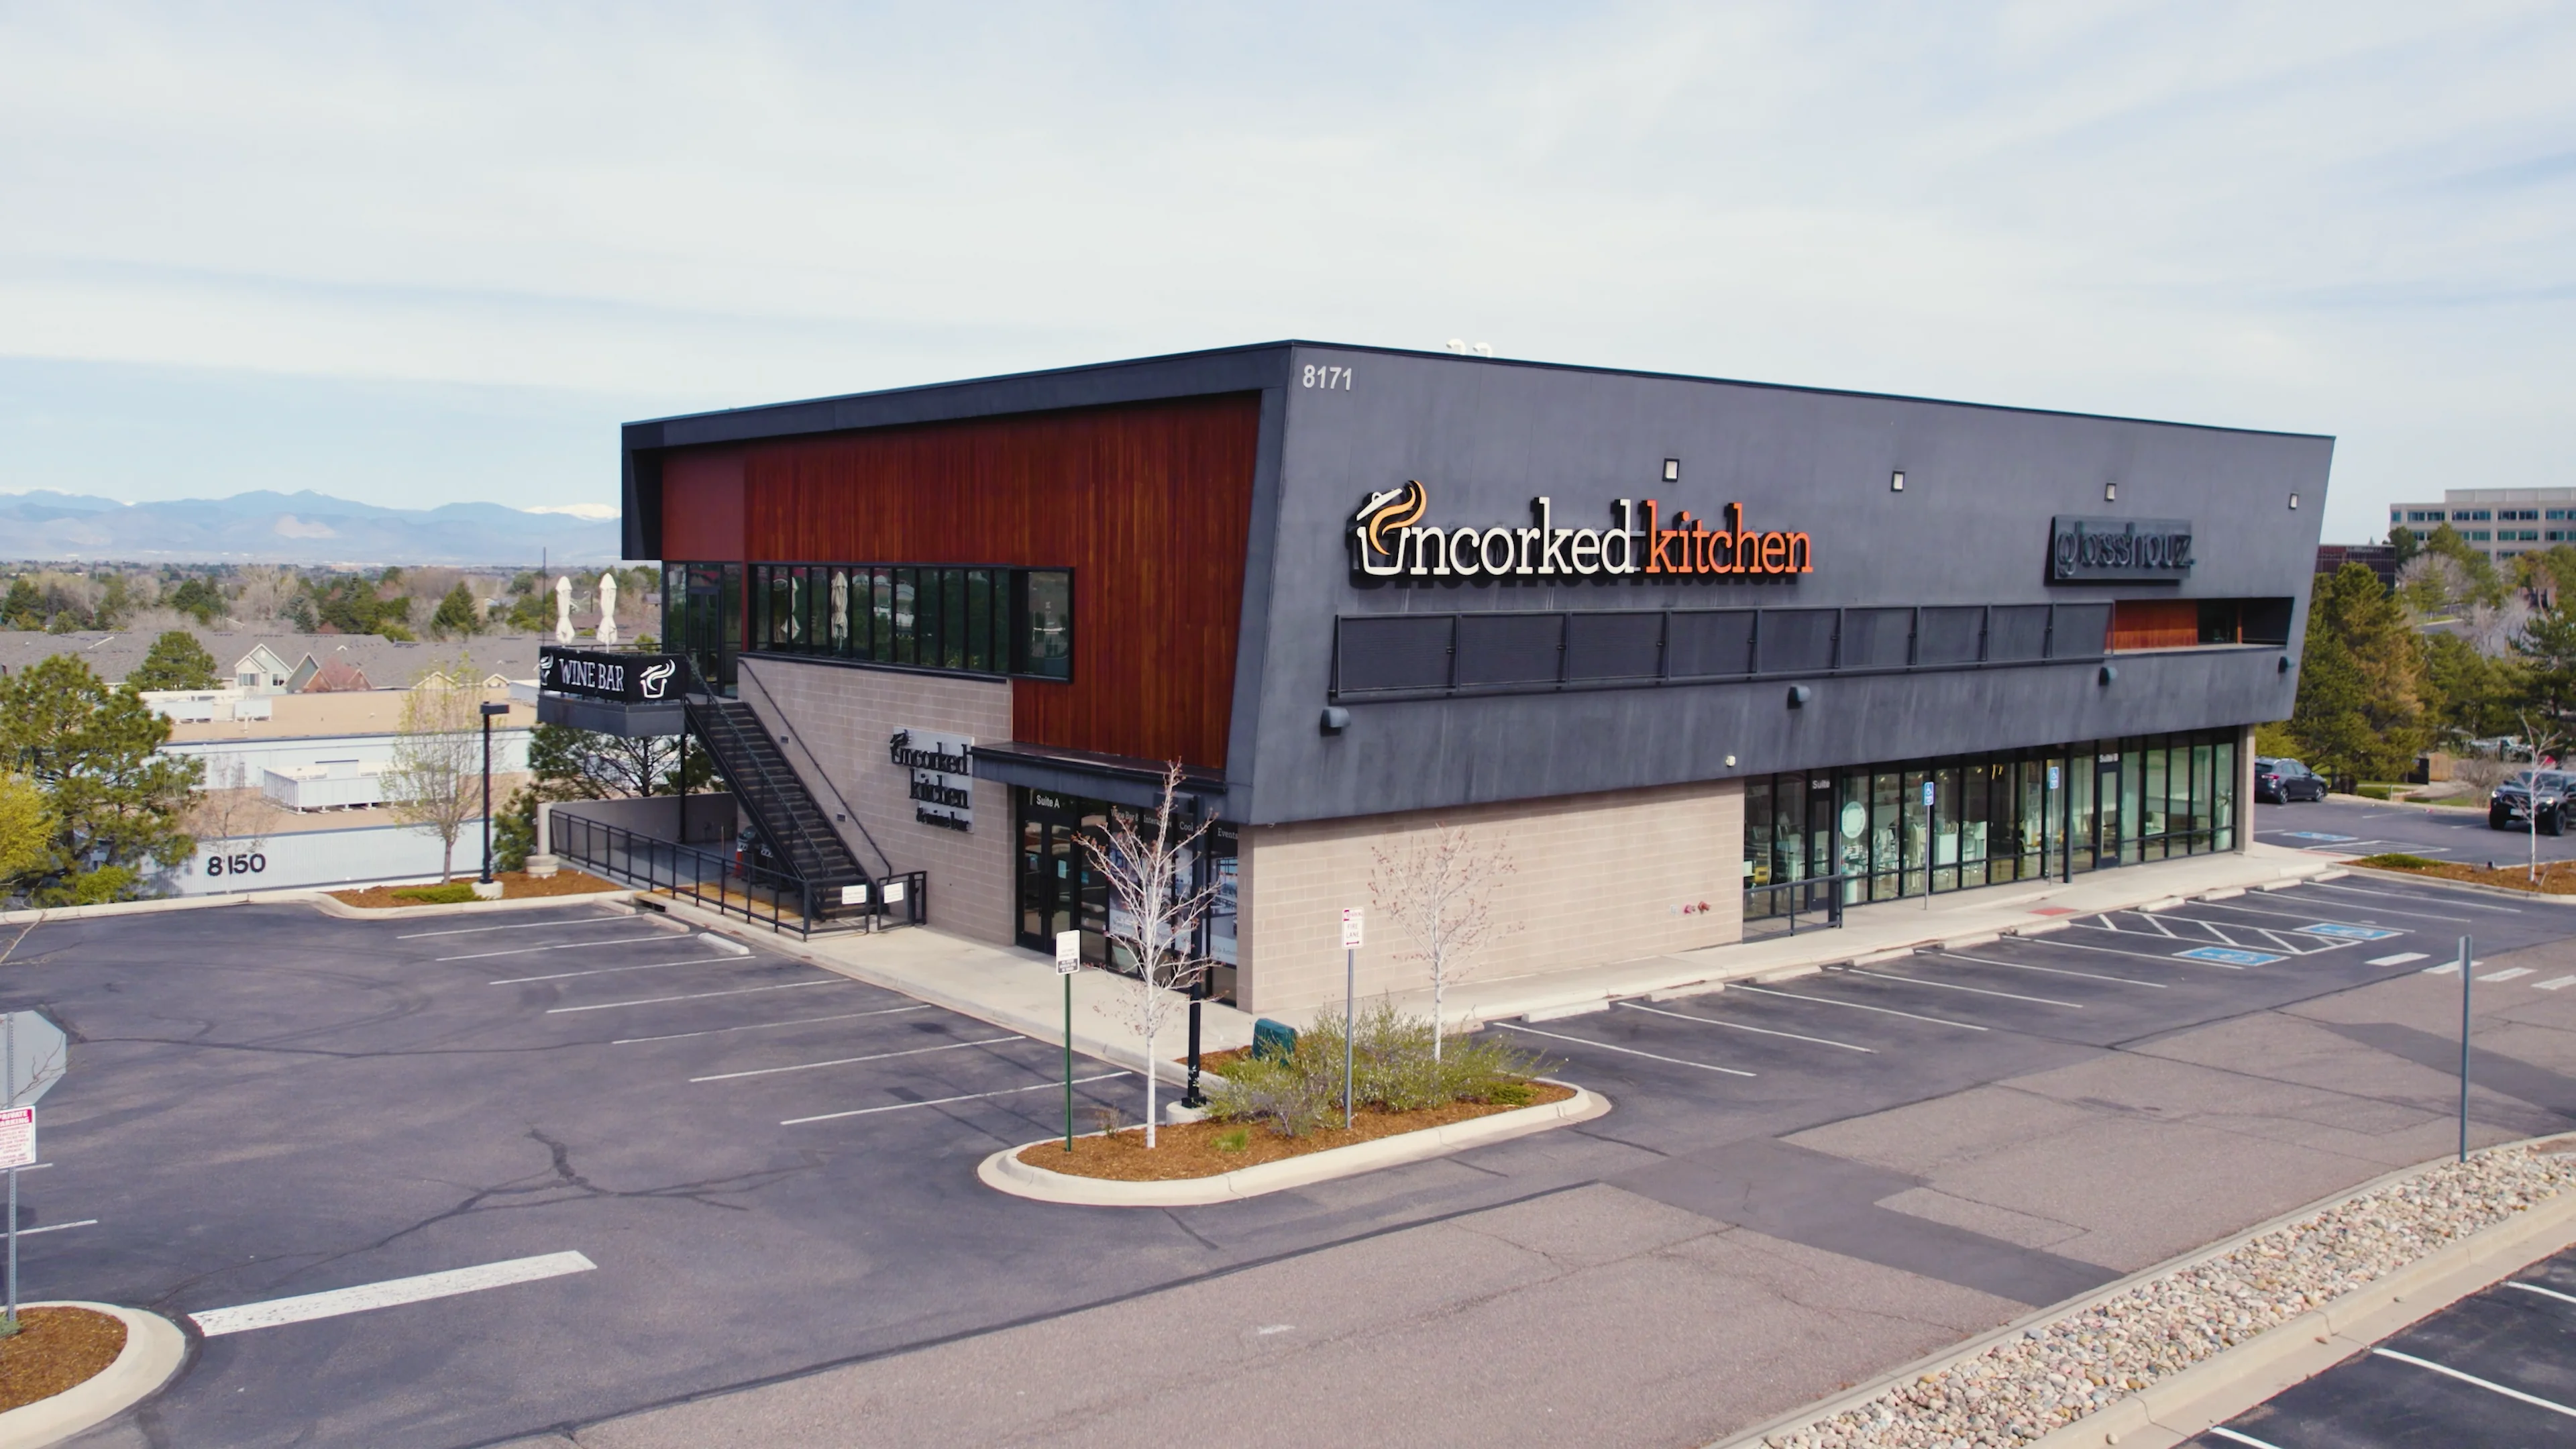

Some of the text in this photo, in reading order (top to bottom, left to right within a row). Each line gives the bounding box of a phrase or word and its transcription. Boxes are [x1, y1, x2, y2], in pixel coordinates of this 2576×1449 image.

[1302, 364, 1352, 391] 8171
[1645, 498, 1814, 574] kitchen
[559, 657, 625, 692] WINE BAR
[1813, 780, 1830, 789] Suite
[1036, 794, 1061, 808] Suite A
[1218, 826, 1238, 839] Events
[207, 853, 266, 877] 8150
[0, 1116, 30, 1126] ARKING
